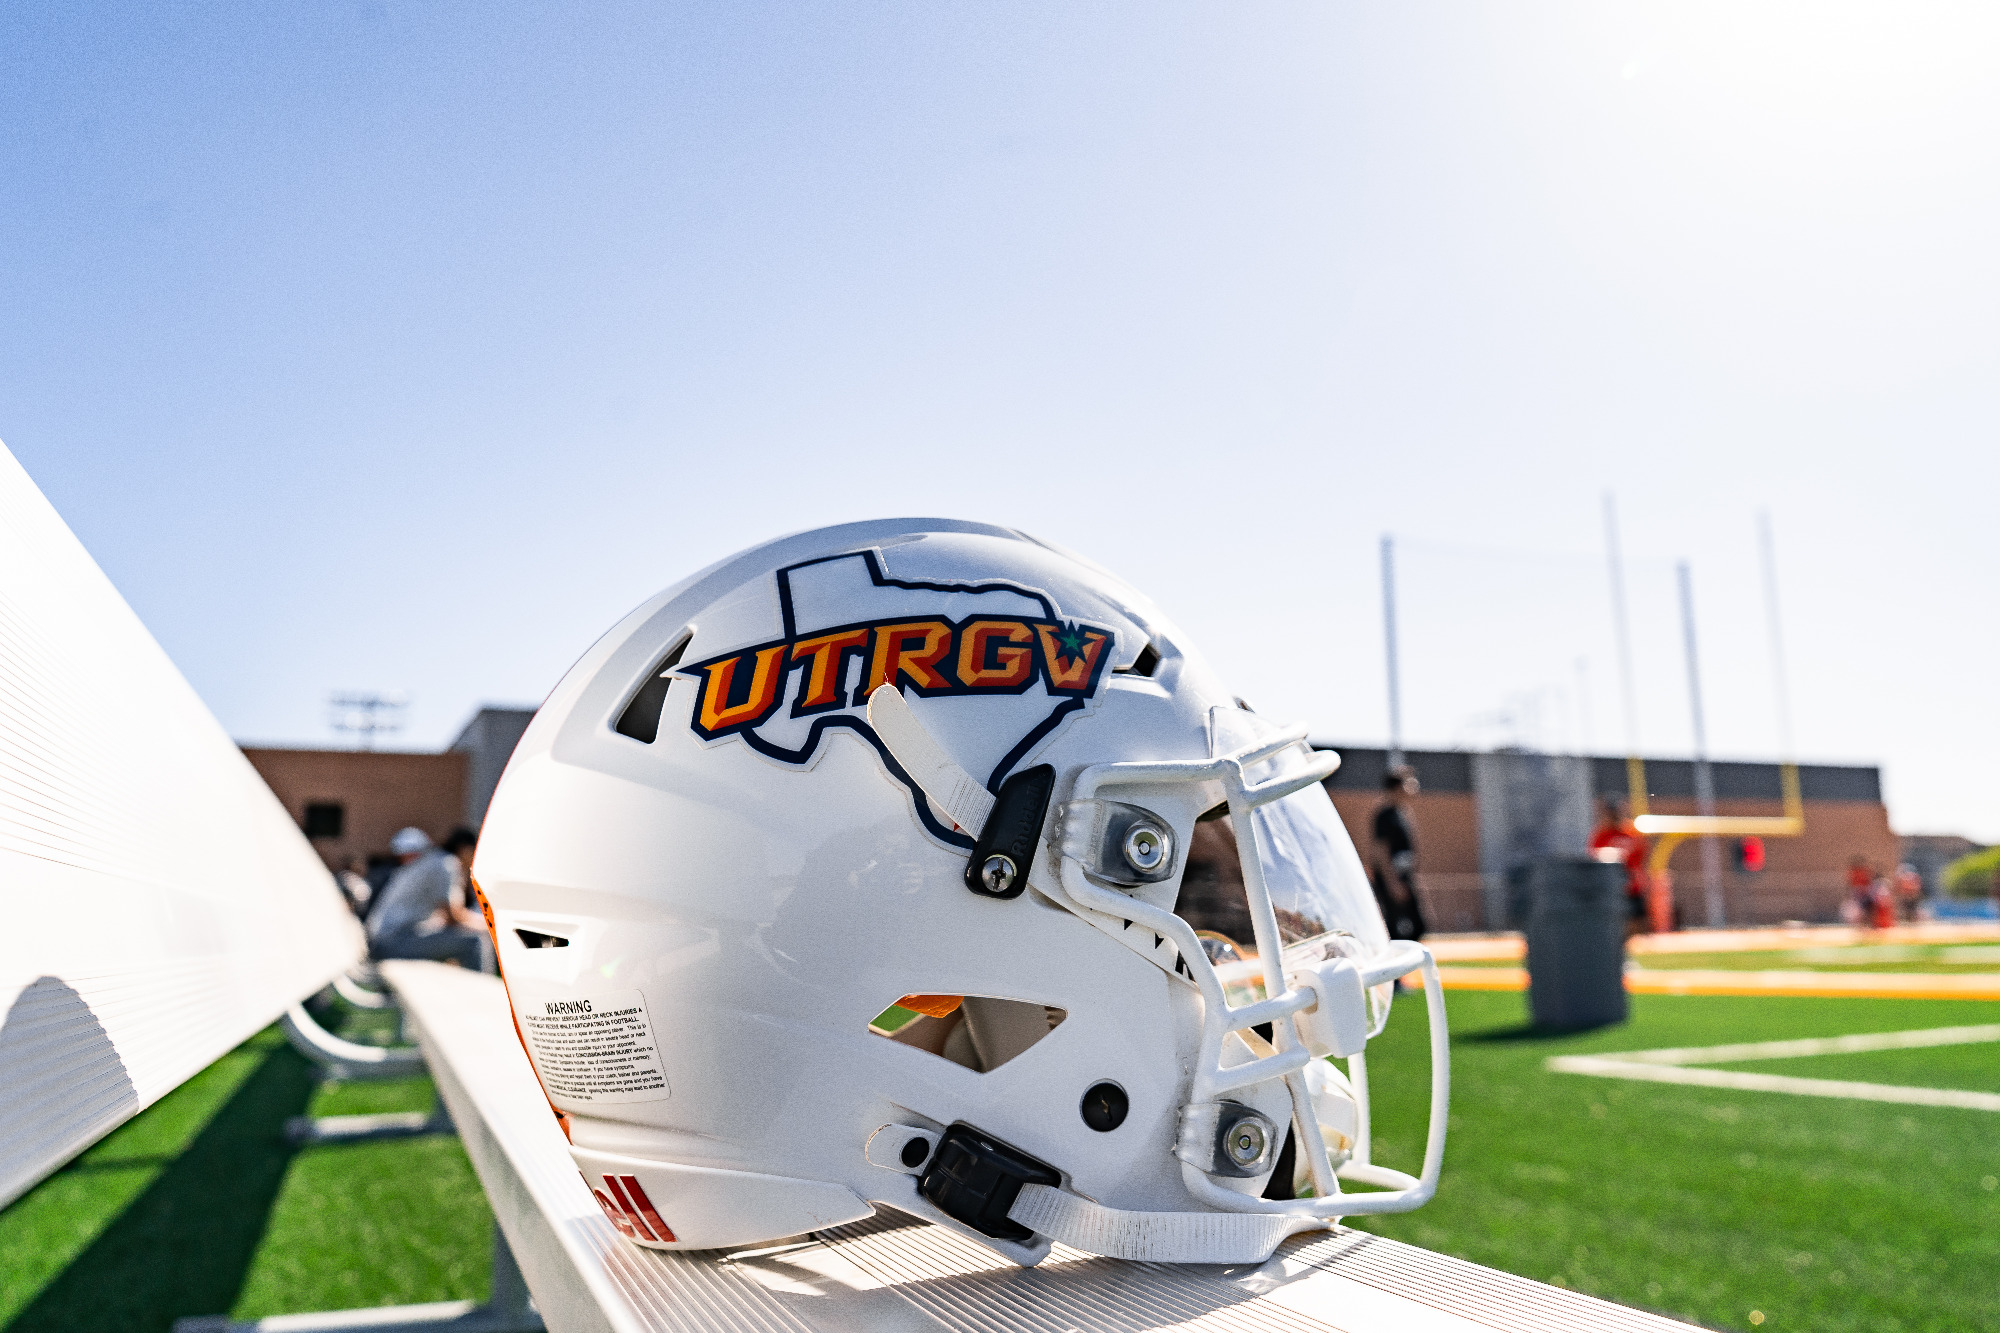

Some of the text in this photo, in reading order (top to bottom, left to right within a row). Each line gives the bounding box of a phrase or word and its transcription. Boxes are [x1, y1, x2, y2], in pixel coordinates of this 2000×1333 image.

[694, 616, 1112, 737] UTRGV
[545, 999, 592, 1015] WARNING
[600, 1011, 613, 1019] NECK
[614, 1008, 637, 1016] INJURIES
[572, 1020, 604, 1028] PARTICIPATING
